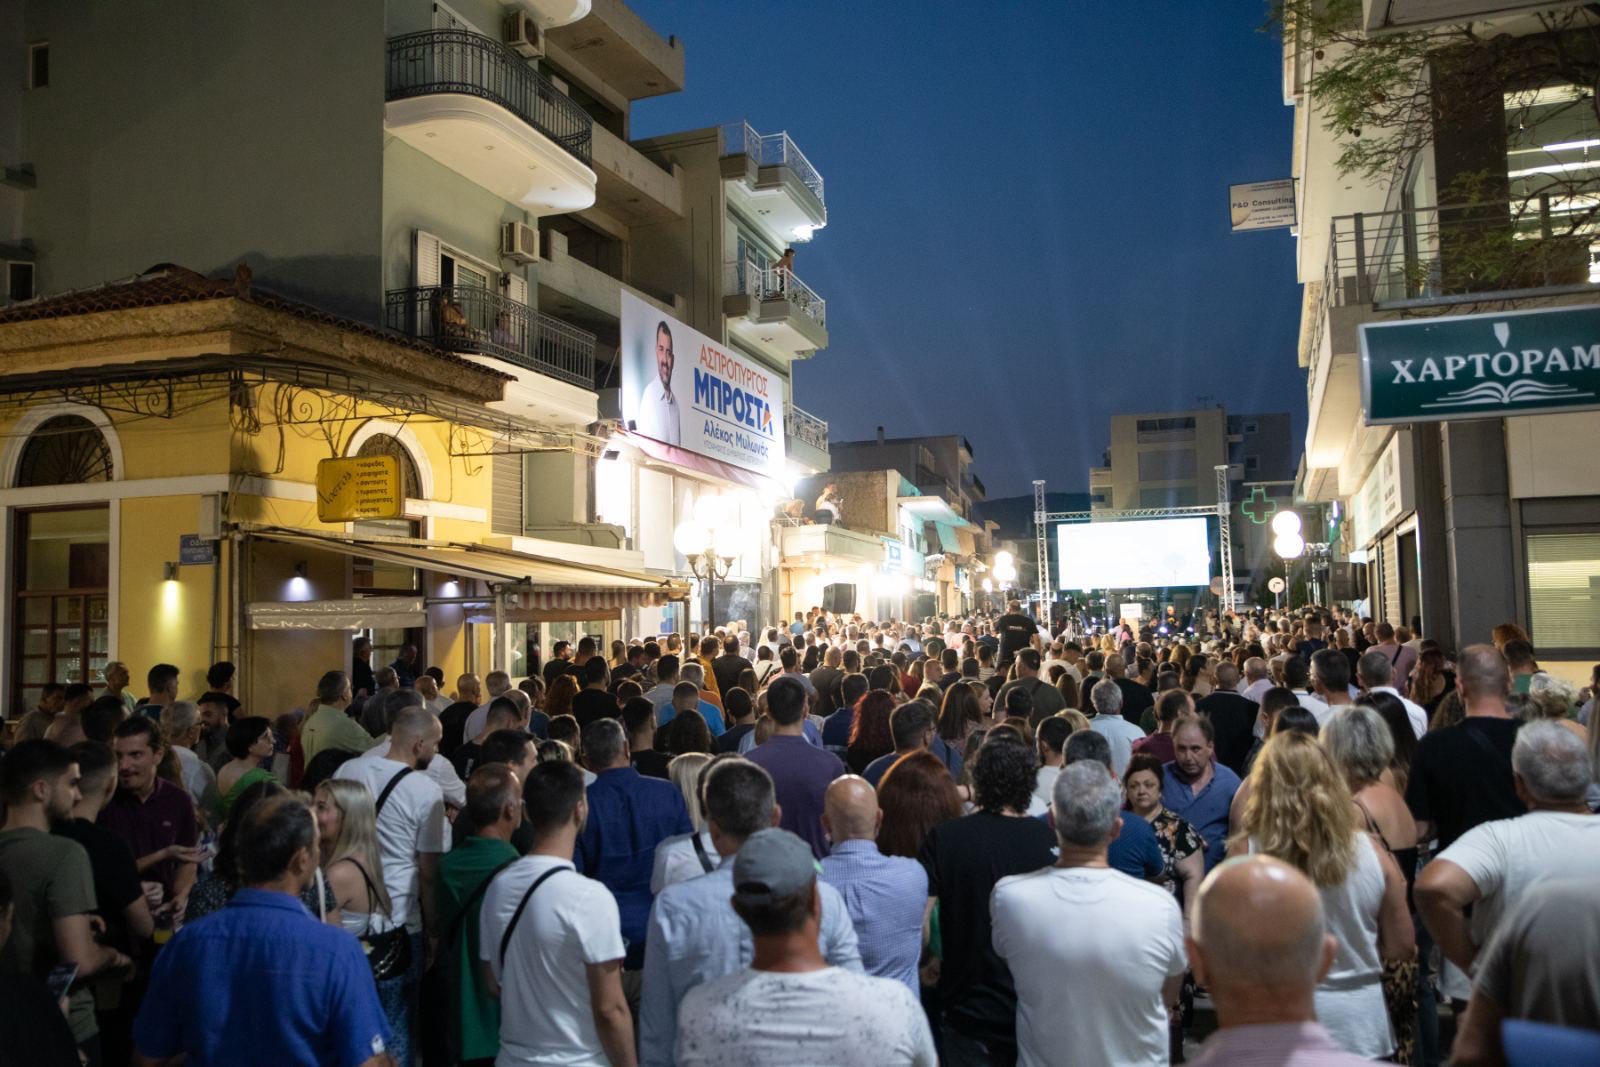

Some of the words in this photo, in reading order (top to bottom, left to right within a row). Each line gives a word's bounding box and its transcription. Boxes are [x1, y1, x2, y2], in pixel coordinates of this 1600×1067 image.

[699, 343, 769, 398] ΑΣΠΡΟΠΥΡΓΟΣ
[1391, 344, 1600, 384] ΧΑΡΤΟΡΑΜ
[694, 367, 774, 436] ΜΠΡΟΣΤΑ
[703, 418, 734, 448] Αλέκος
[735, 431, 769, 458] Μυλωνάς
